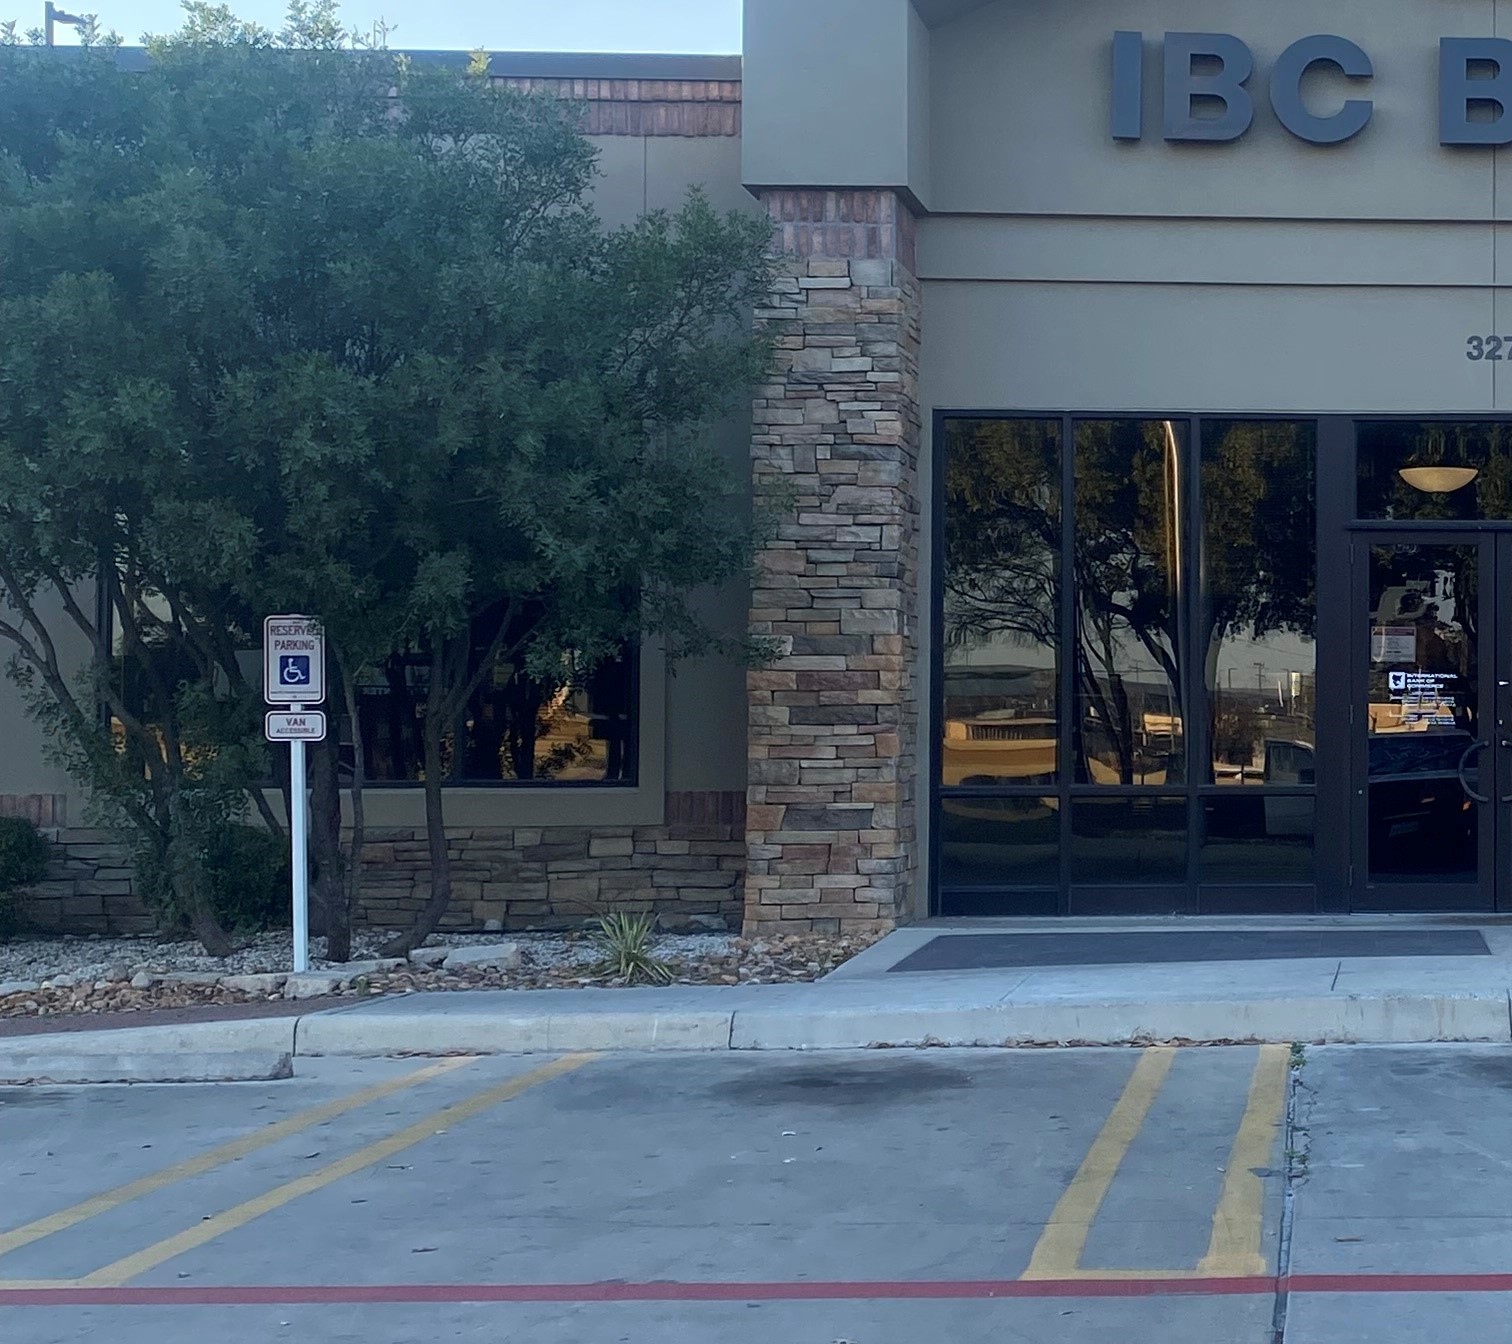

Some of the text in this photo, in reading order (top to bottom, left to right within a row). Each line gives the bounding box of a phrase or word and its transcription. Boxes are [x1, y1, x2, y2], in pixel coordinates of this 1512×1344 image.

[1112, 30, 1374, 143] IBC
[274, 639, 315, 650] PARKING
[286, 718, 306, 727] VAN
